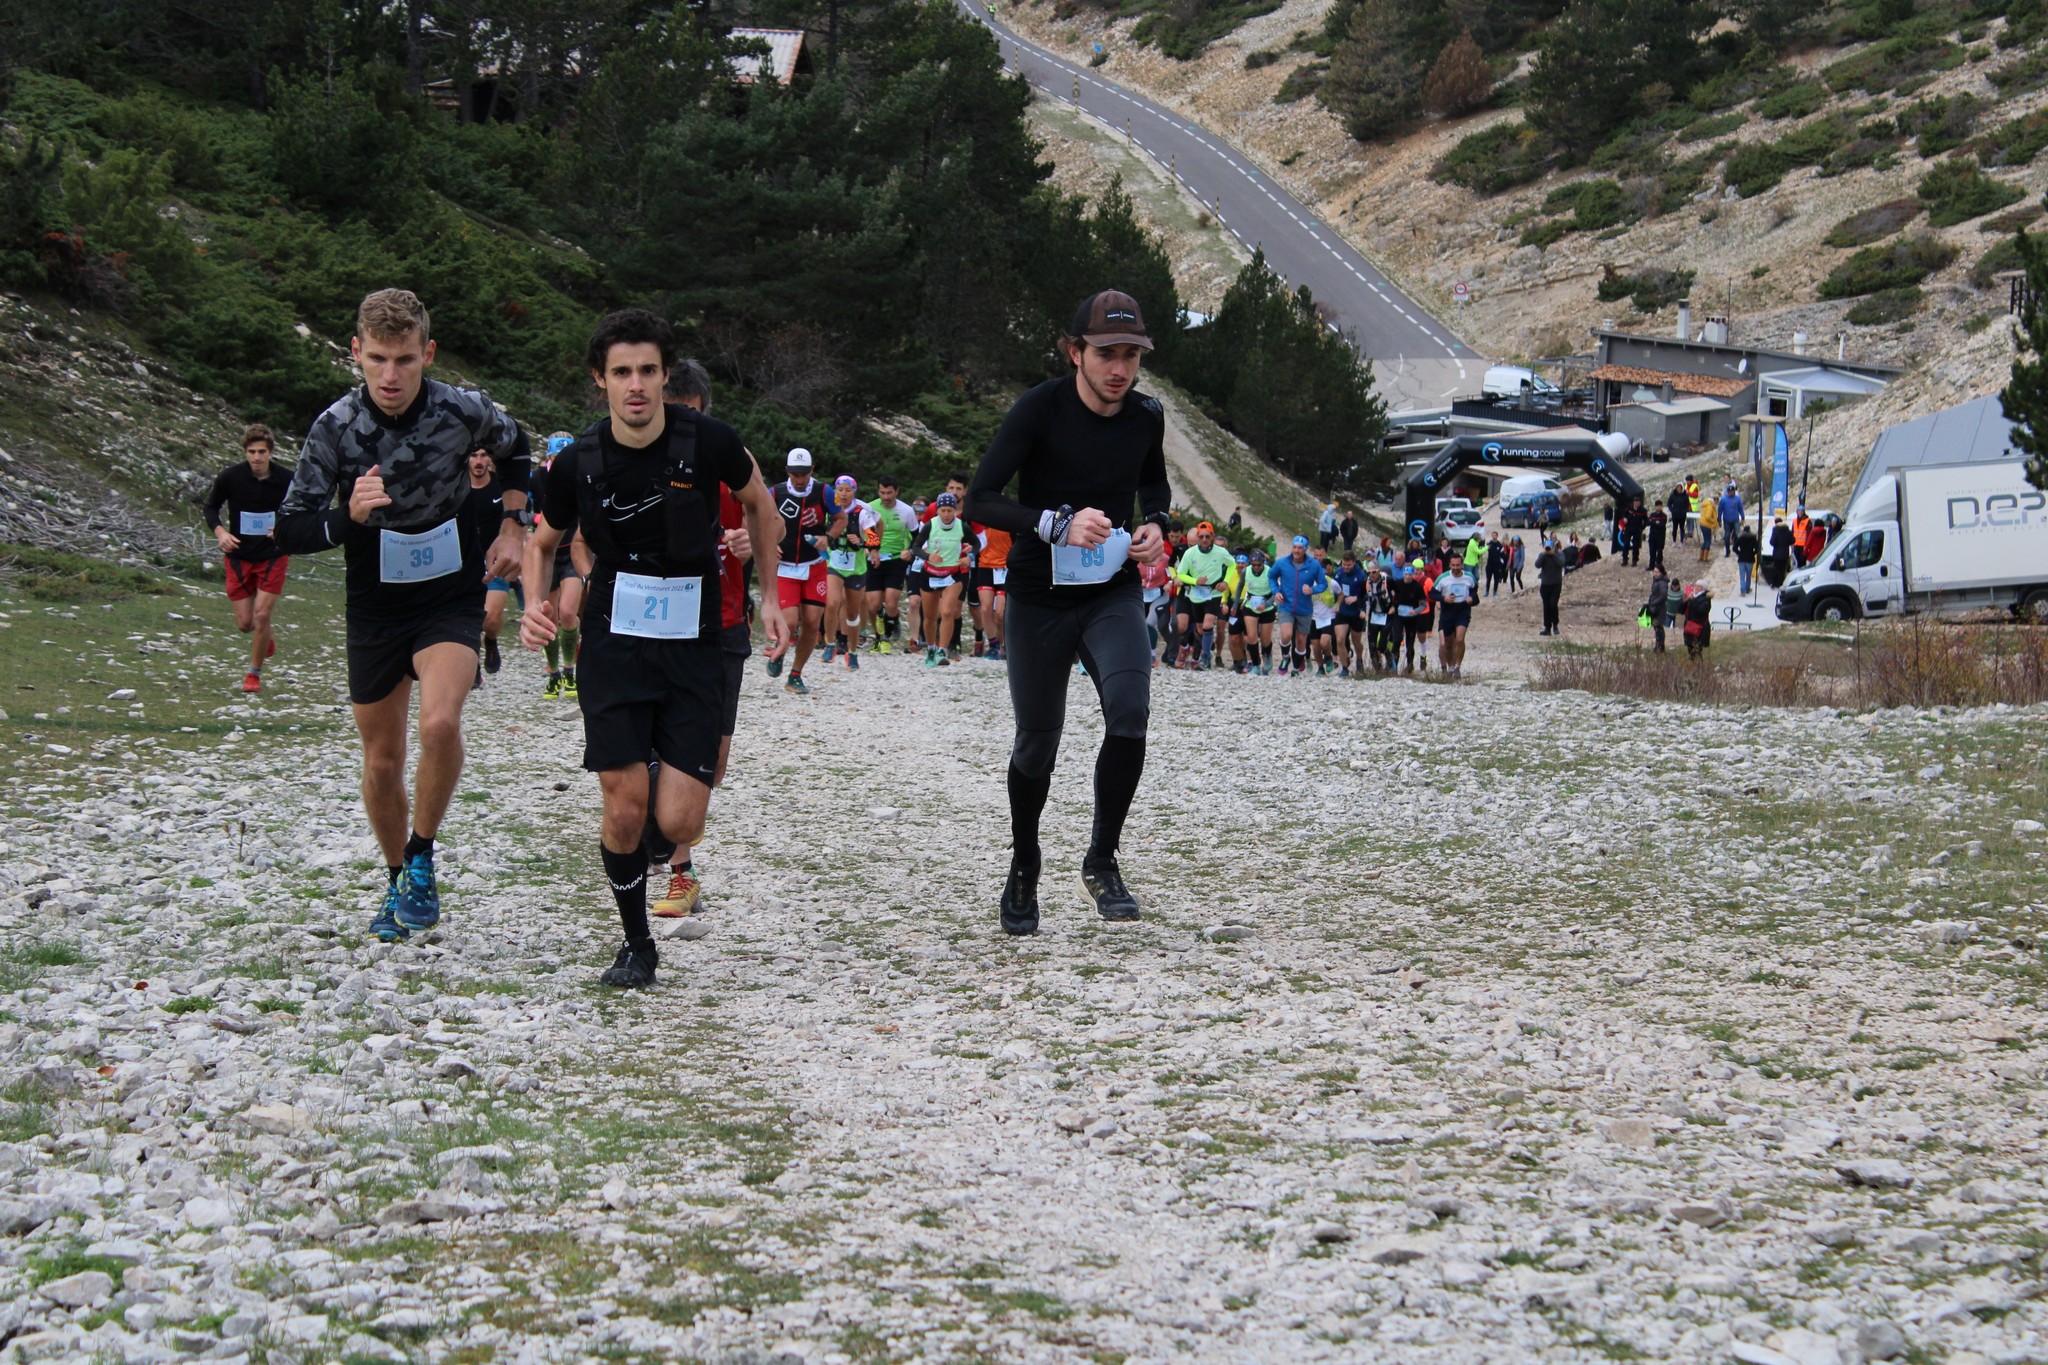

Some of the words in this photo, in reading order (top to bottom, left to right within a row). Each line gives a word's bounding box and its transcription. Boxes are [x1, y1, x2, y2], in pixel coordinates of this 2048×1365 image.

[1502, 447, 1539, 458] running
[1539, 449, 1565, 457] conseil
[670, 481, 693, 489] EVADICT
[410, 546, 434, 568] 39
[1081, 543, 1105, 568] 89
[643, 595, 669, 621] 21
